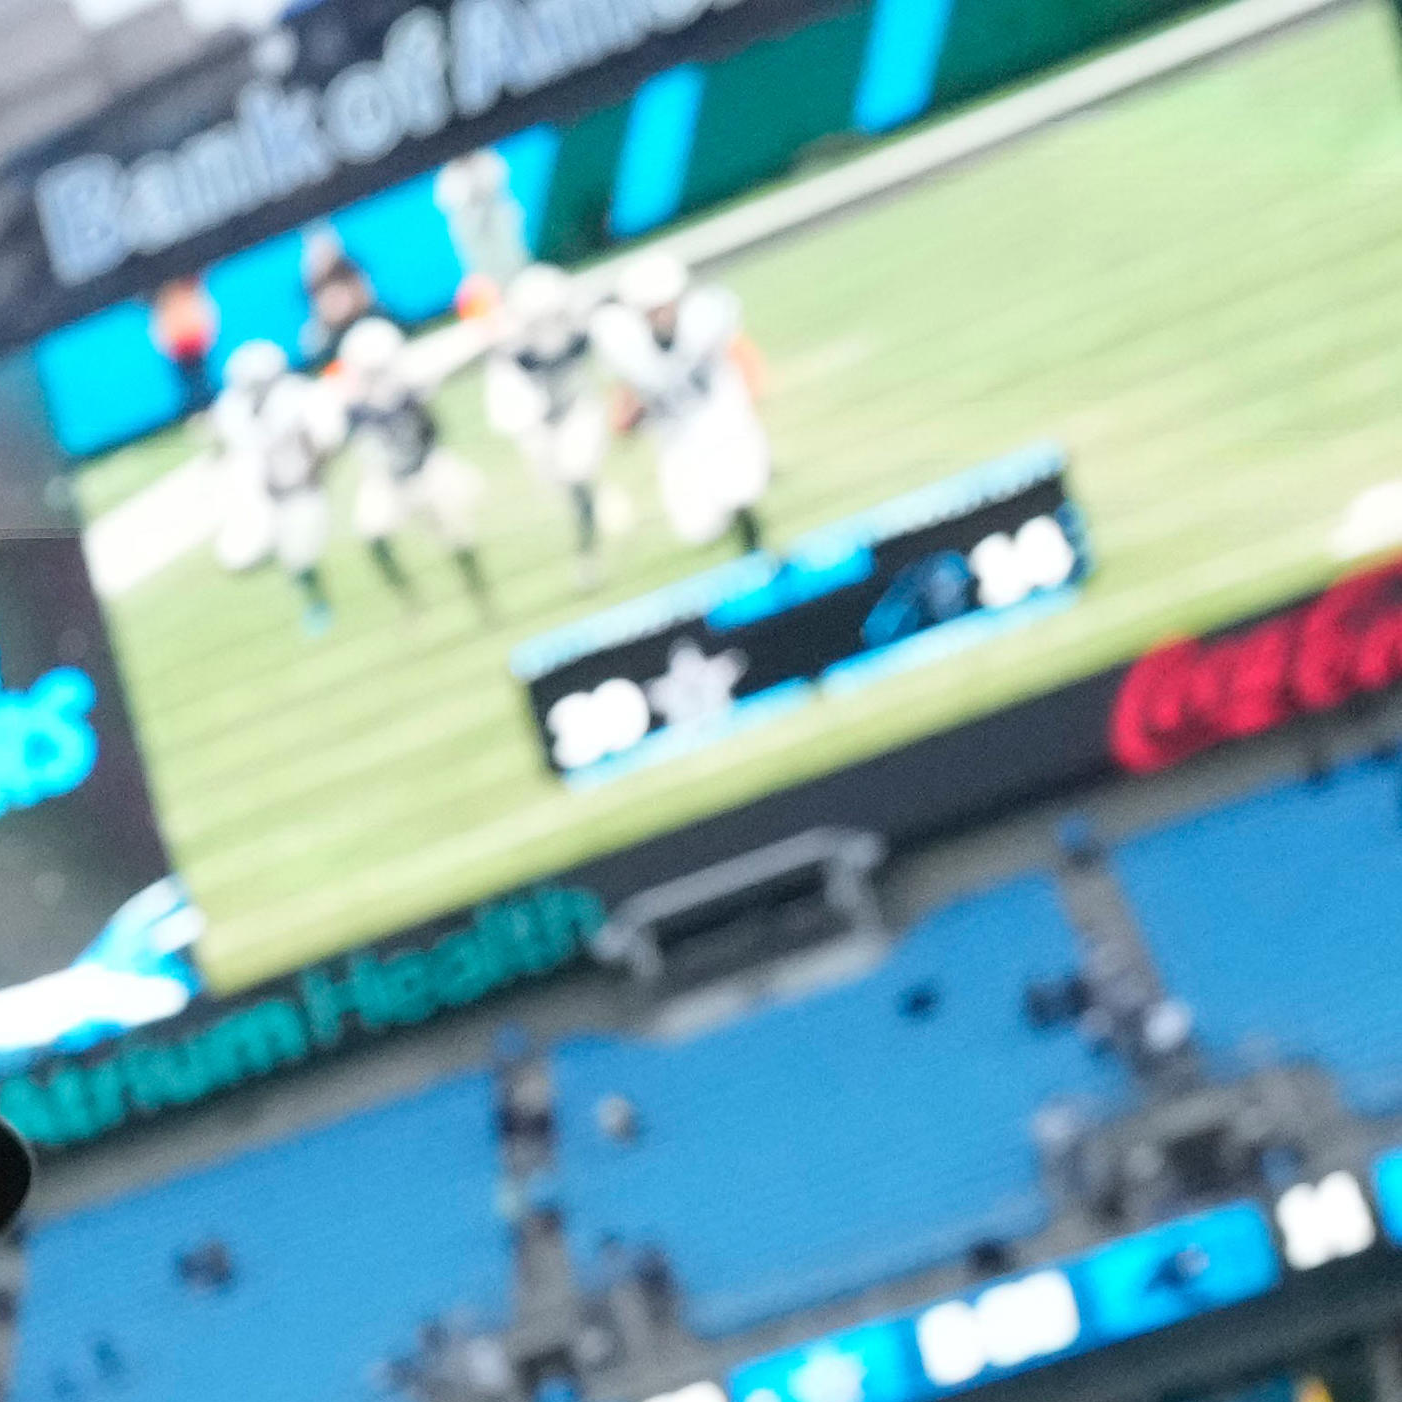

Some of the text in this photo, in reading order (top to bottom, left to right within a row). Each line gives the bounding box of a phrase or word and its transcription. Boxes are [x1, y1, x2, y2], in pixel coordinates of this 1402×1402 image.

[37, 80, 329, 283] Bank
[327, 5, 447, 162] of
[303, 886, 605, 1045] Health
